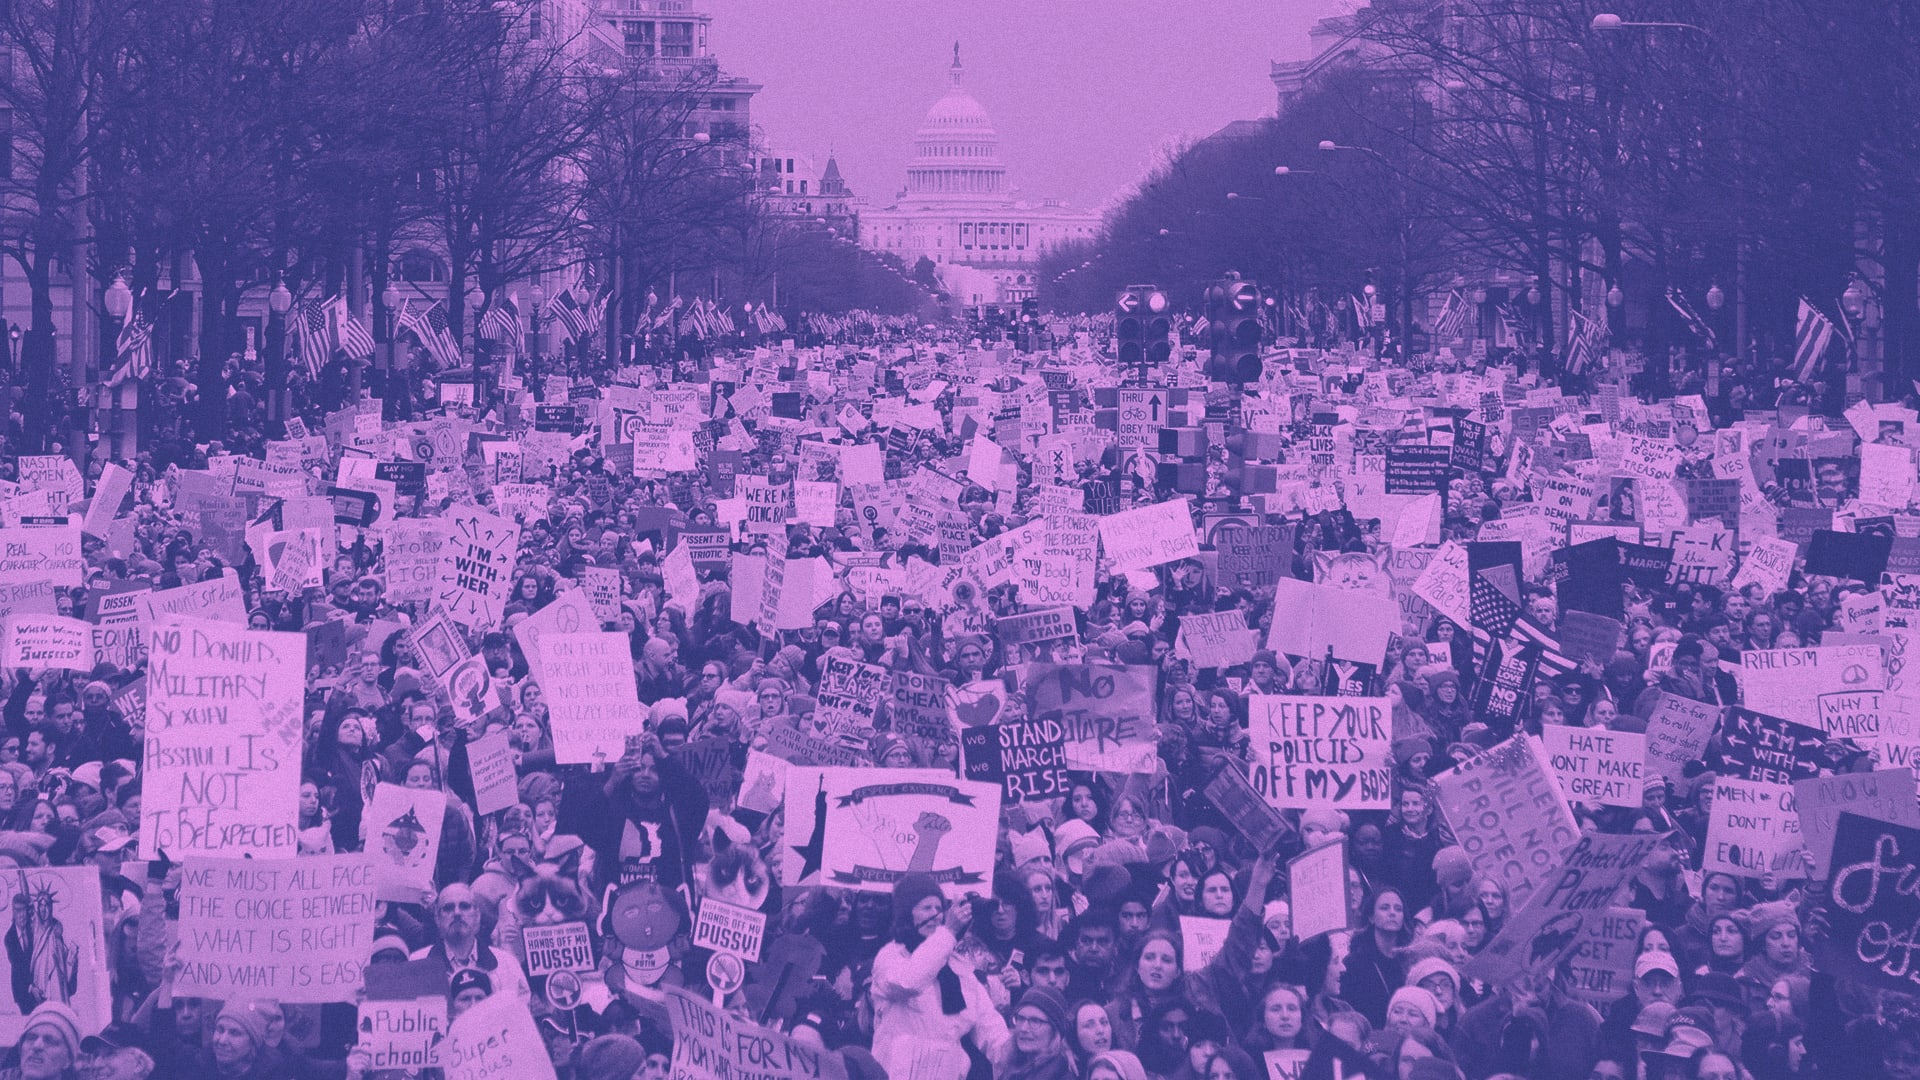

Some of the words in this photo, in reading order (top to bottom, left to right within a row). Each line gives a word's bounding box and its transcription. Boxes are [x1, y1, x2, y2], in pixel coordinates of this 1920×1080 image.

[1122, 393, 1144, 402] THRU
[1121, 425, 1143, 434] OBEY
[1310, 439, 1335, 451] LIVES
[1630, 437, 1674, 452] TRUMP
[20, 457, 60, 468] NASTY
[1624, 460, 1672, 480] TREASON
[1720, 459, 1744, 474] YES
[20, 469, 64, 481] WOMEN
[1545, 480, 1593, 496] ABORTION
[1559, 496, 1573, 506] ON
[1044, 517, 1061, 531] THE
[1246, 527, 1265, 544] MY
[1266, 526, 1295, 543] BODY
[942, 530, 965, 541] PLACE
[1044, 534, 1061, 546] THE
[1061, 533, 1088, 546] PEOPLE
[1160, 533, 1196, 558] RIGHT
[387, 541, 443, 554] STORM
[467, 544, 493, 563] I'M
[454, 556, 498, 582] WITH
[1022, 557, 1043, 577] my
[1044, 562, 1072, 587] Body
[1629, 556, 1668, 570] MARCH
[11, 581, 53, 603] RIGHTS
[456, 573, 489, 596] HER
[1021, 578, 1039, 596] my
[91, 626, 145, 649] EQUAL
[152, 630, 181, 654] NO
[1028, 623, 1073, 639] STAND
[1202, 634, 1227, 646] THIS
[553, 643, 573, 656] ON
[1744, 650, 1818, 670] RACISM
[149, 659, 267, 701] MILITARY
[545, 662, 590, 678] BRIGHT
[600, 661, 627, 677] SIDE
[1497, 669, 1521, 683] LOVE
[558, 683, 580, 699] NO
[585, 682, 624, 698] MORE
[829, 675, 879, 703] LAWS
[1059, 666, 1115, 704] NO
[1492, 686, 1517, 702] NO
[114, 688, 145, 716] WE
[818, 694, 839, 709] OUT
[1489, 699, 1513, 716] HATE
[1824, 697, 1861, 714] WHY
[1873, 696, 1880, 710] I
[895, 721, 949, 740] SCHOOLS
[1267, 702, 1331, 737] KEEP
[1329, 703, 1387, 740] YOUR
[965, 733, 987, 746] we
[998, 718, 1062, 748] STAND
[1569, 734, 1614, 754] HATE
[1657, 732, 1678, 745] and
[1760, 728, 1795, 751] I'M
[237, 734, 279, 771] IS
[775, 735, 813, 757] CANNOT
[782, 729, 802, 743] OUR
[806, 738, 851, 761] CLIMATE
[1269, 737, 1364, 765] POLICIES
[970, 760, 989, 773] we
[1000, 746, 1066, 773] MARCH
[1597, 759, 1642, 778] MAKE
[1752, 746, 1796, 770] WITH
[180, 772, 247, 810] NOT
[478, 774, 515, 795] FORMATION
[855, 784, 898, 798] RESPECT
[901, 783, 956, 796] EXISTENCE
[1005, 770, 1070, 798] RISE
[1253, 763, 1303, 798] OFF
[1305, 769, 1357, 802] MY
[1360, 769, 1390, 801] BODY
[1571, 778, 1632, 800] GREAT!
[1819, 777, 1878, 803] NOW
[1716, 785, 1755, 804] MEN
[205, 808, 297, 849] EXPECTED
[1728, 814, 1771, 831] DON'T
[895, 832, 917, 845] OR
[1454, 817, 1493, 871] YOU
[1461, 777, 1535, 894] PROTECT
[1565, 837, 1624, 869] Protect
[184, 867, 215, 887] WE
[227, 869, 282, 892] MUST
[288, 868, 323, 890] ALL
[332, 864, 374, 887] FACE
[854, 868, 898, 881] EXPECT
[1543, 869, 1625, 910] Planet
[189, 896, 225, 919] THE
[235, 896, 293, 920] CHOICE
[301, 896, 373, 917] BETWEEN
[702, 910, 729, 925] HANDS
[732, 918, 747, 931] OFF
[748, 923, 762, 934] MY
[193, 928, 258, 954] WHAT
[270, 929, 292, 953] IS
[300, 923, 361, 951] RIGHT
[528, 939, 555, 950] HANDS
[556, 938, 573, 948] OFF
[575, 936, 587, 946] MY
[697, 924, 759, 957] PUSSY!
[530, 948, 592, 971] PUSSY!
[1577, 940, 1614, 960] GET
[180, 961, 223, 985] AND
[227, 965, 281, 987] WHAT
[291, 965, 312, 986] IS
[320, 957, 369, 985] EASY
[1568, 966, 1616, 993] STUFF
[376, 1009, 439, 1034] Public
[450, 1027, 509, 1069] Super
[679, 996, 715, 1038] THIS
[720, 1017, 732, 1053] IS
[736, 1033, 782, 1070] FOR
[783, 1042, 820, 1078] MY
[676, 1031, 709, 1070] MOM
